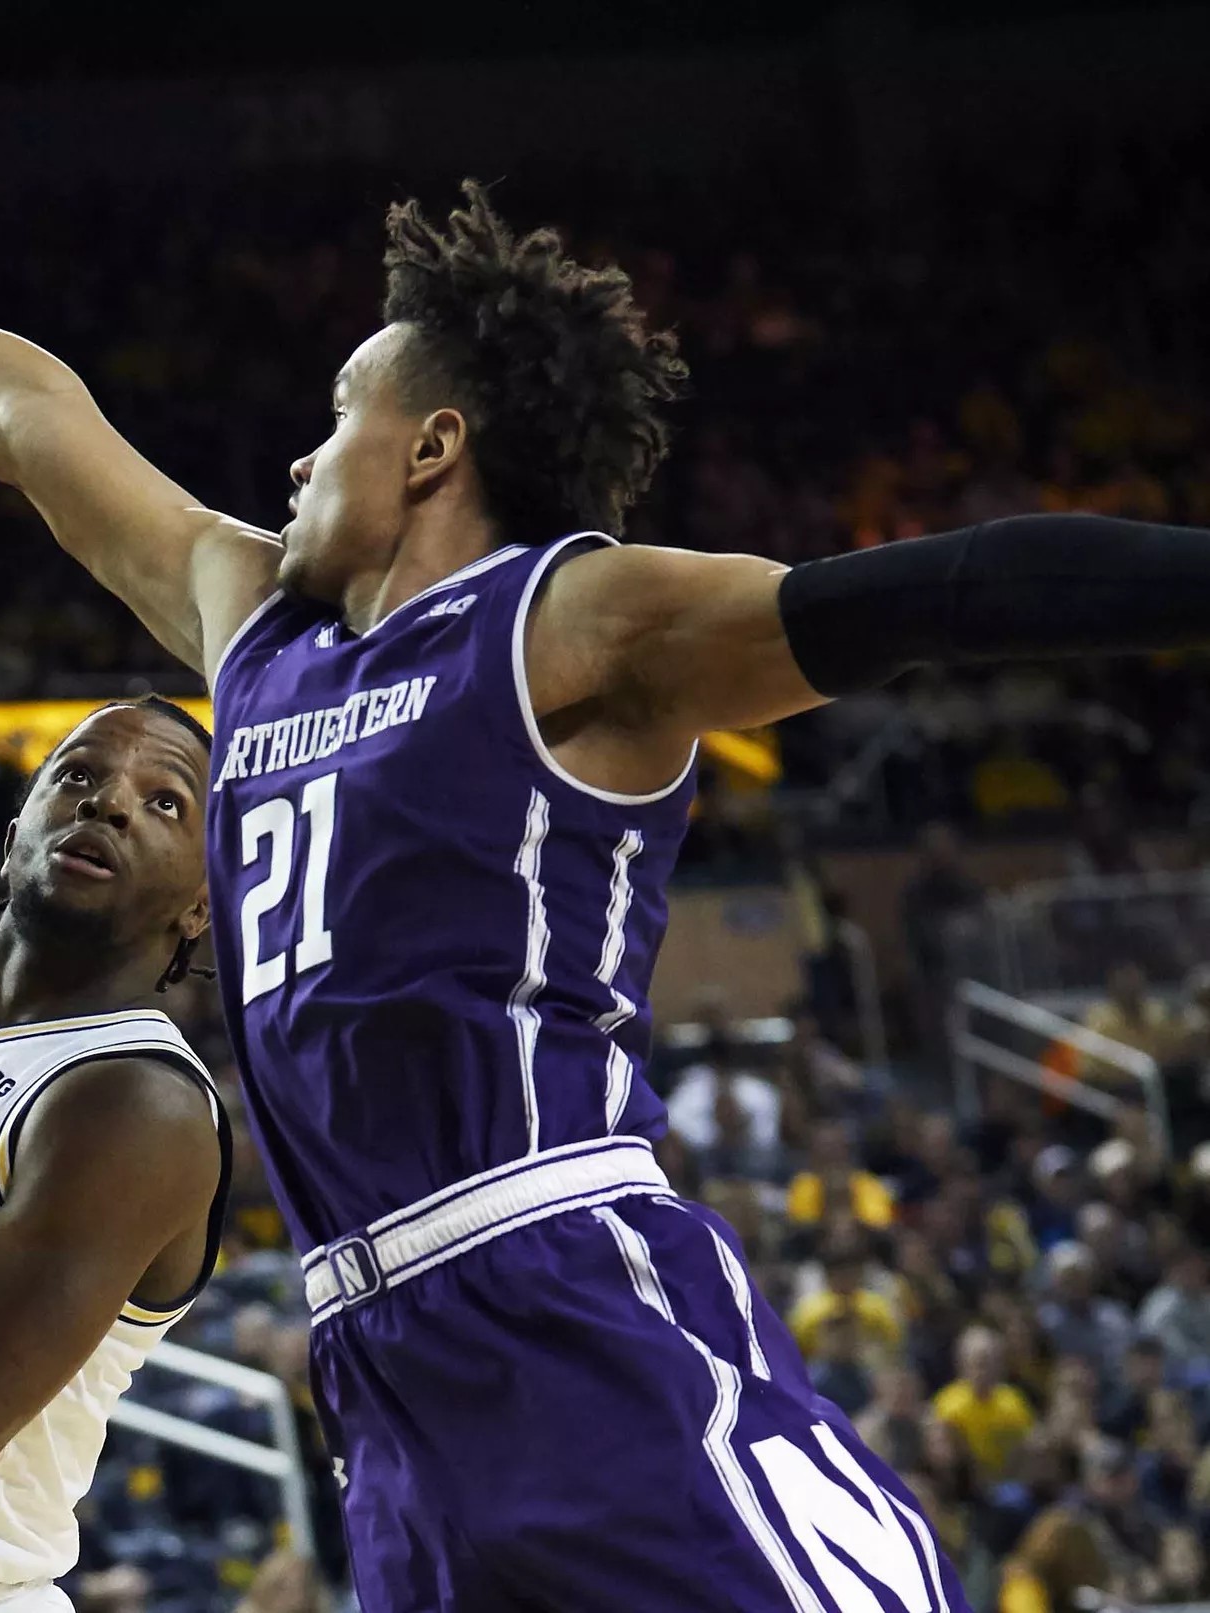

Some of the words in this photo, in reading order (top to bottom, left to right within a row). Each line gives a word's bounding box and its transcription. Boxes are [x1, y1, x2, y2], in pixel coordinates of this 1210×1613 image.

[213, 676, 437, 792] RTHWESTERN
[241, 772, 338, 1006] 21
[334, 1246, 368, 1297] N
[749, 1419, 933, 1613] N
